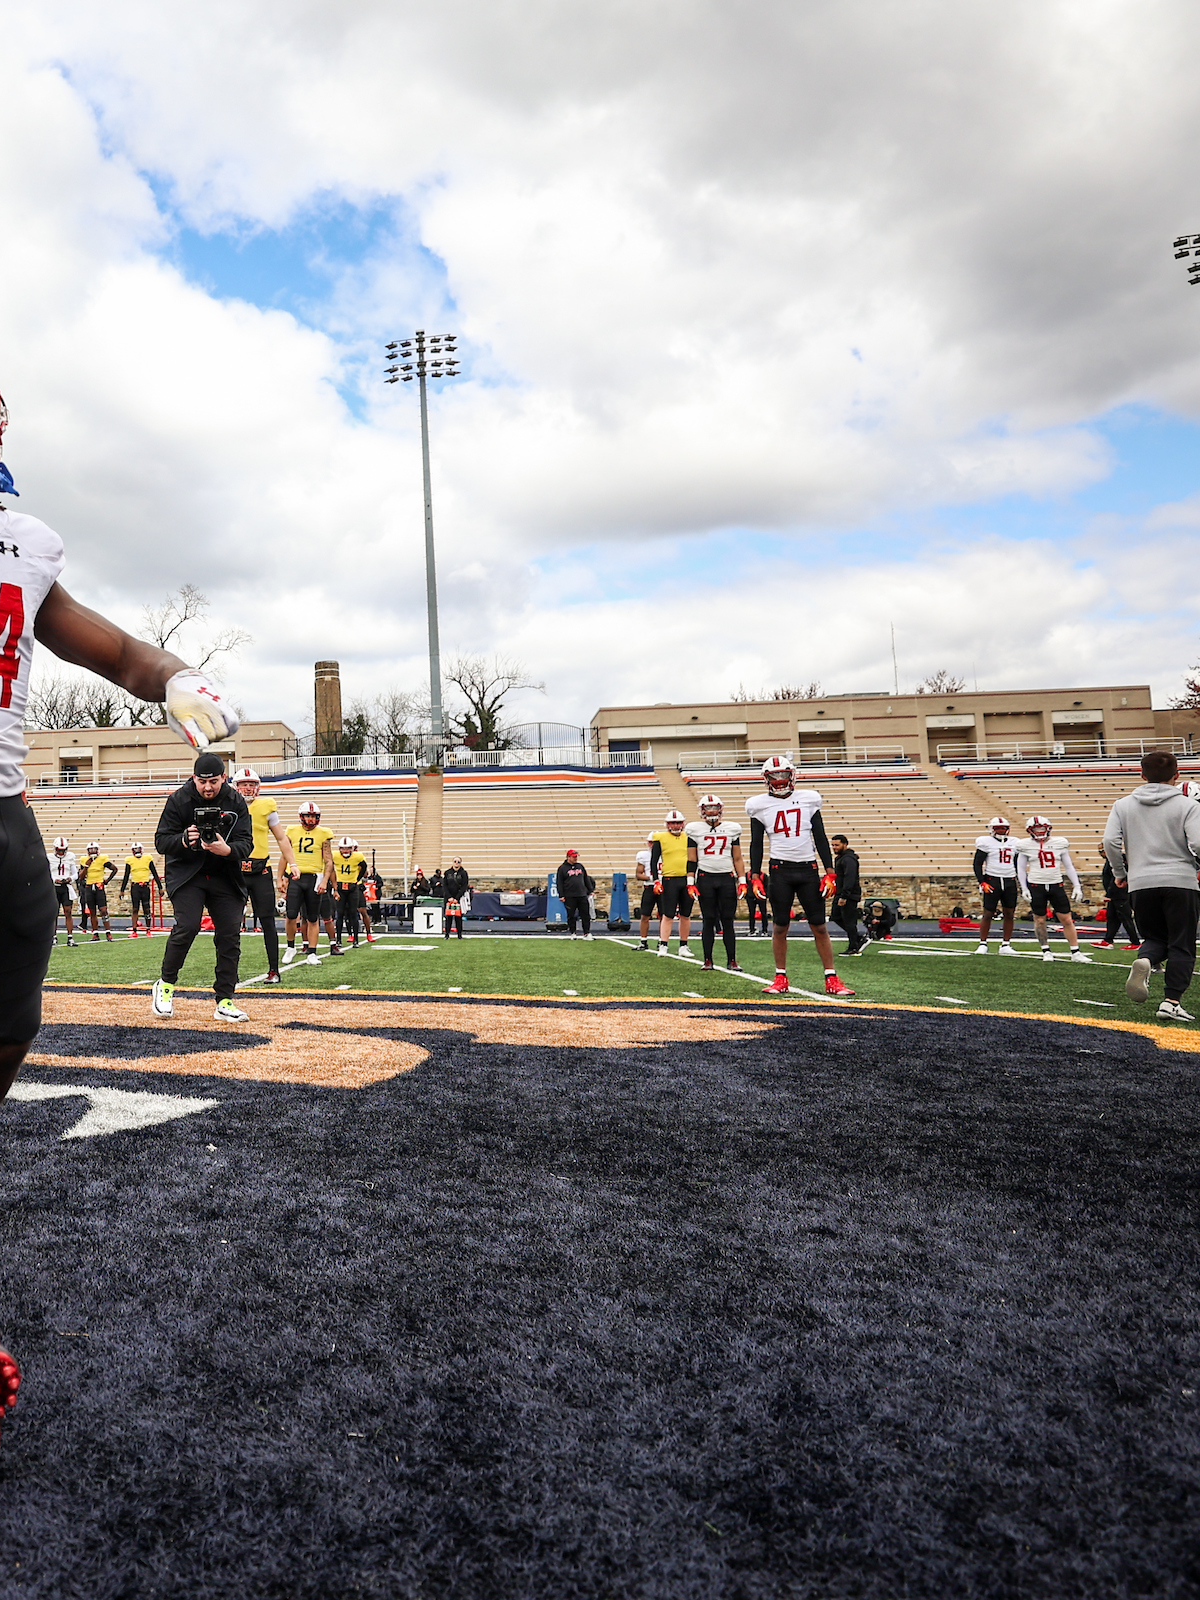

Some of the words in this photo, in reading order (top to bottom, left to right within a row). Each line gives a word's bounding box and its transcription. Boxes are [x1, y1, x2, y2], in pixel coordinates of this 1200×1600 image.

[774, 808, 801, 838] 47
[298, 837, 314, 853] 12
[703, 835, 727, 855] 27
[999, 848, 1011, 863] 16
[1038, 850, 1056, 869] 19
[341, 864, 351, 875] 14
[423, 912, 434, 929] 1
